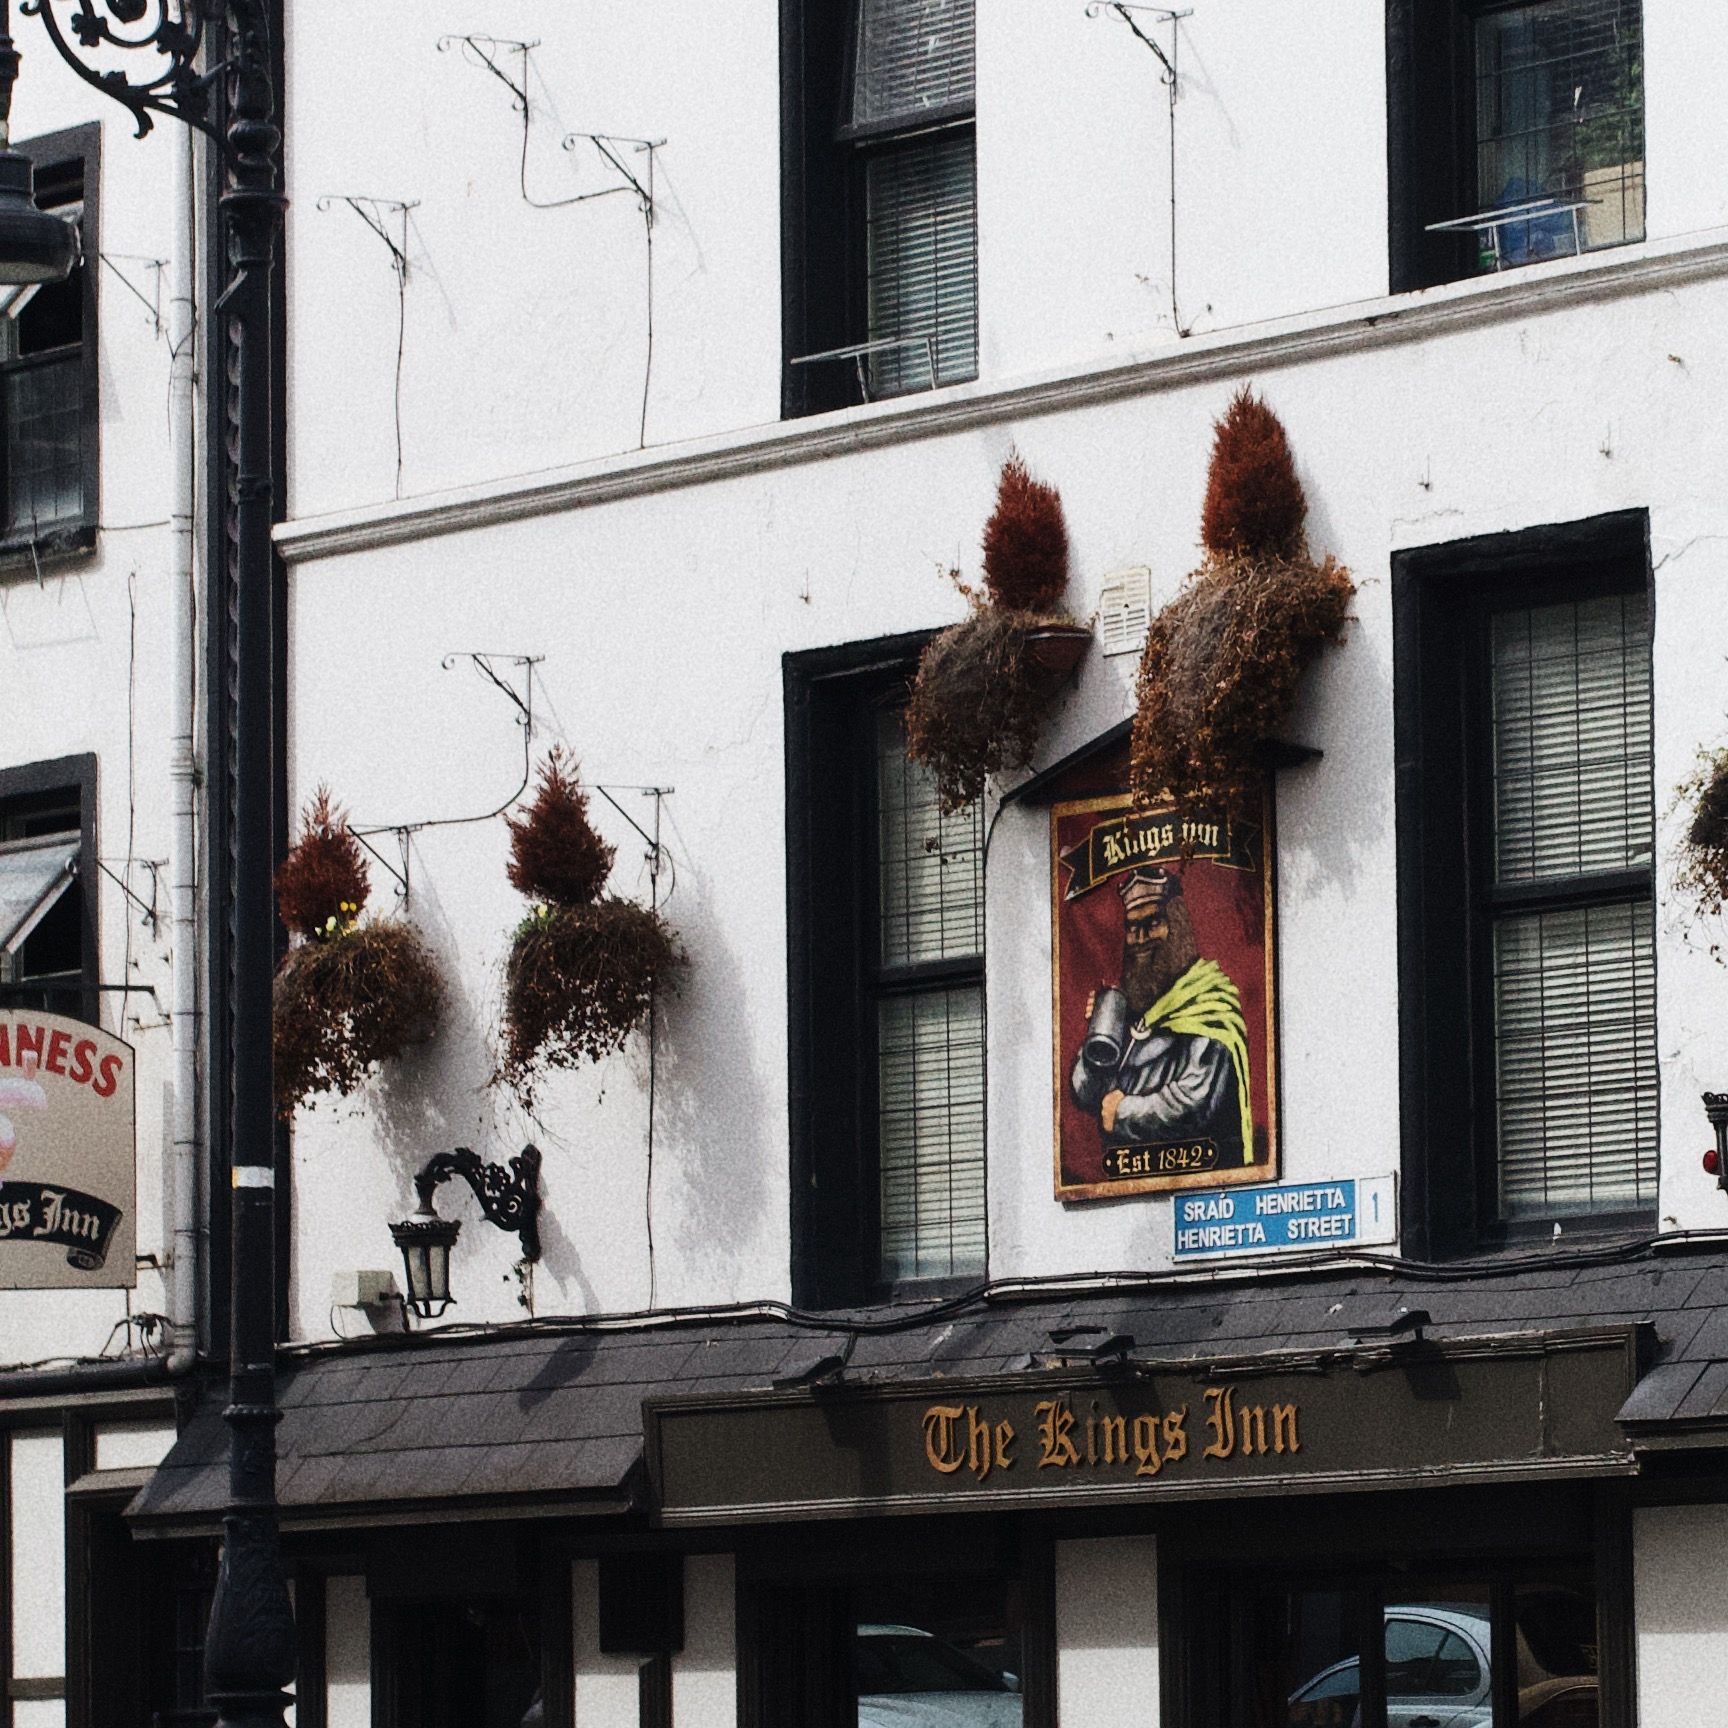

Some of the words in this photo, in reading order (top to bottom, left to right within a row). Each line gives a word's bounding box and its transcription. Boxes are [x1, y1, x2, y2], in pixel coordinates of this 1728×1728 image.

[1103, 824, 1173, 866] Kings
[1117, 1149, 1150, 1174] Est
[1158, 1145, 1202, 1170] 1842
[34, 1190, 100, 1242] Inn
[1183, 1192, 1235, 1222] SRAÍD
[1256, 1187, 1345, 1215] HENRIETTA
[1370, 1191, 1379, 1223] 1
[1177, 1222, 1266, 1250] HENRIETTA
[1287, 1214, 1353, 1240] STREET
[923, 1403, 1017, 1481] The
[1033, 1398, 1189, 1476] Kings
[1202, 1386, 1303, 1460] Inn
